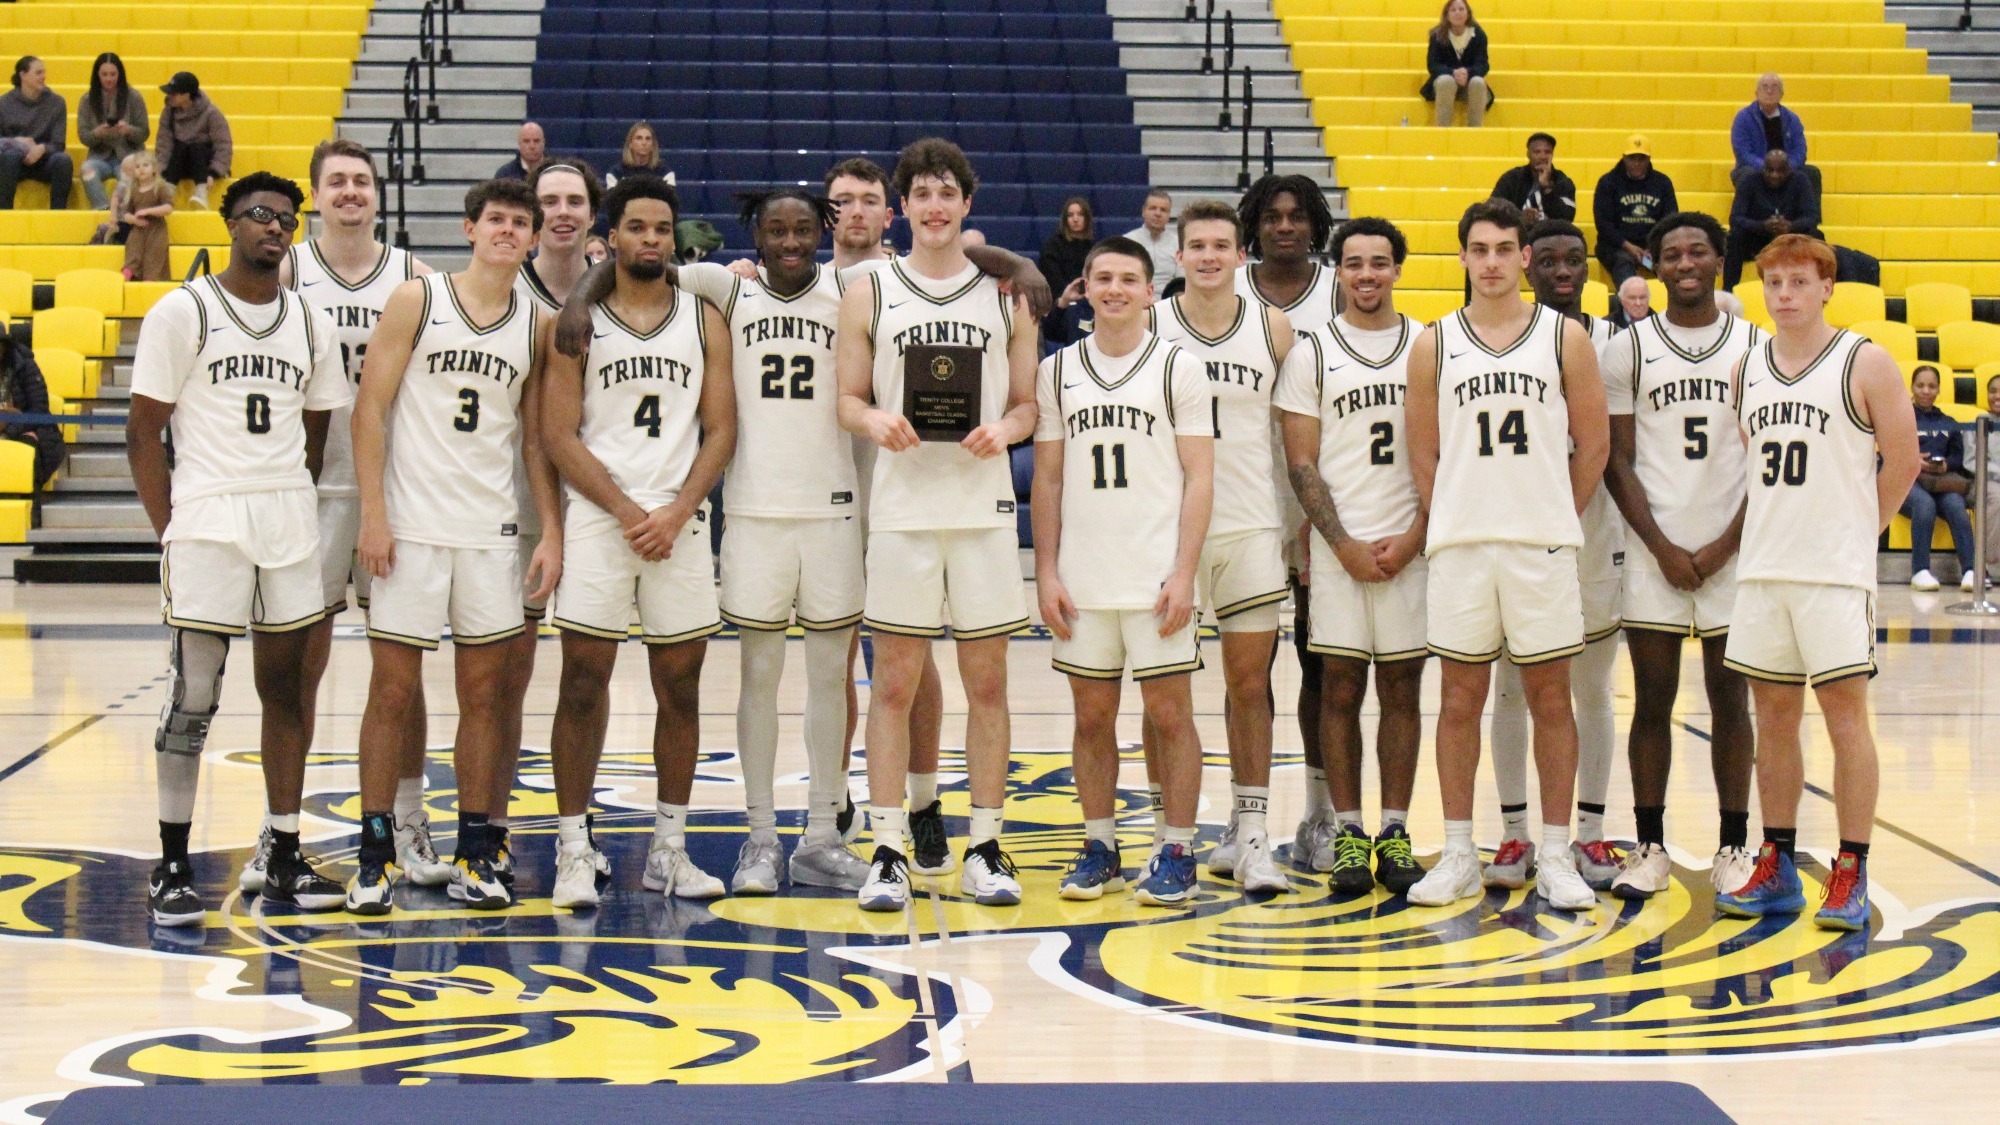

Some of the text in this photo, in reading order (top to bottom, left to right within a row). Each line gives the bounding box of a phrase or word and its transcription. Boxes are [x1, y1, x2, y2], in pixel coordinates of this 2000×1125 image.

[742, 316, 836, 351] TRINITY
[893, 320, 992, 357] TRINITY
[208, 354, 304, 392] TRINITY
[426, 349, 519, 389] TRINITY
[598, 356, 692, 390] TRINITY
[761, 354, 815, 400] 22
[1454, 371, 1548, 407] TRINITY
[245, 393, 271, 435] 0
[453, 387, 480, 433] 3
[1648, 378, 1736, 412] TRINIT
[633, 394, 662, 438] 4
[1067, 405, 1156, 436] TRINITY
[1477, 410, 1529, 457] 14
[1748, 401, 1831, 436] TRINITY
[1370, 421, 1395, 466] 2
[1684, 416, 1708, 460] 5
[1091, 443, 1128, 489] 11
[1761, 440, 1808, 487] 30
